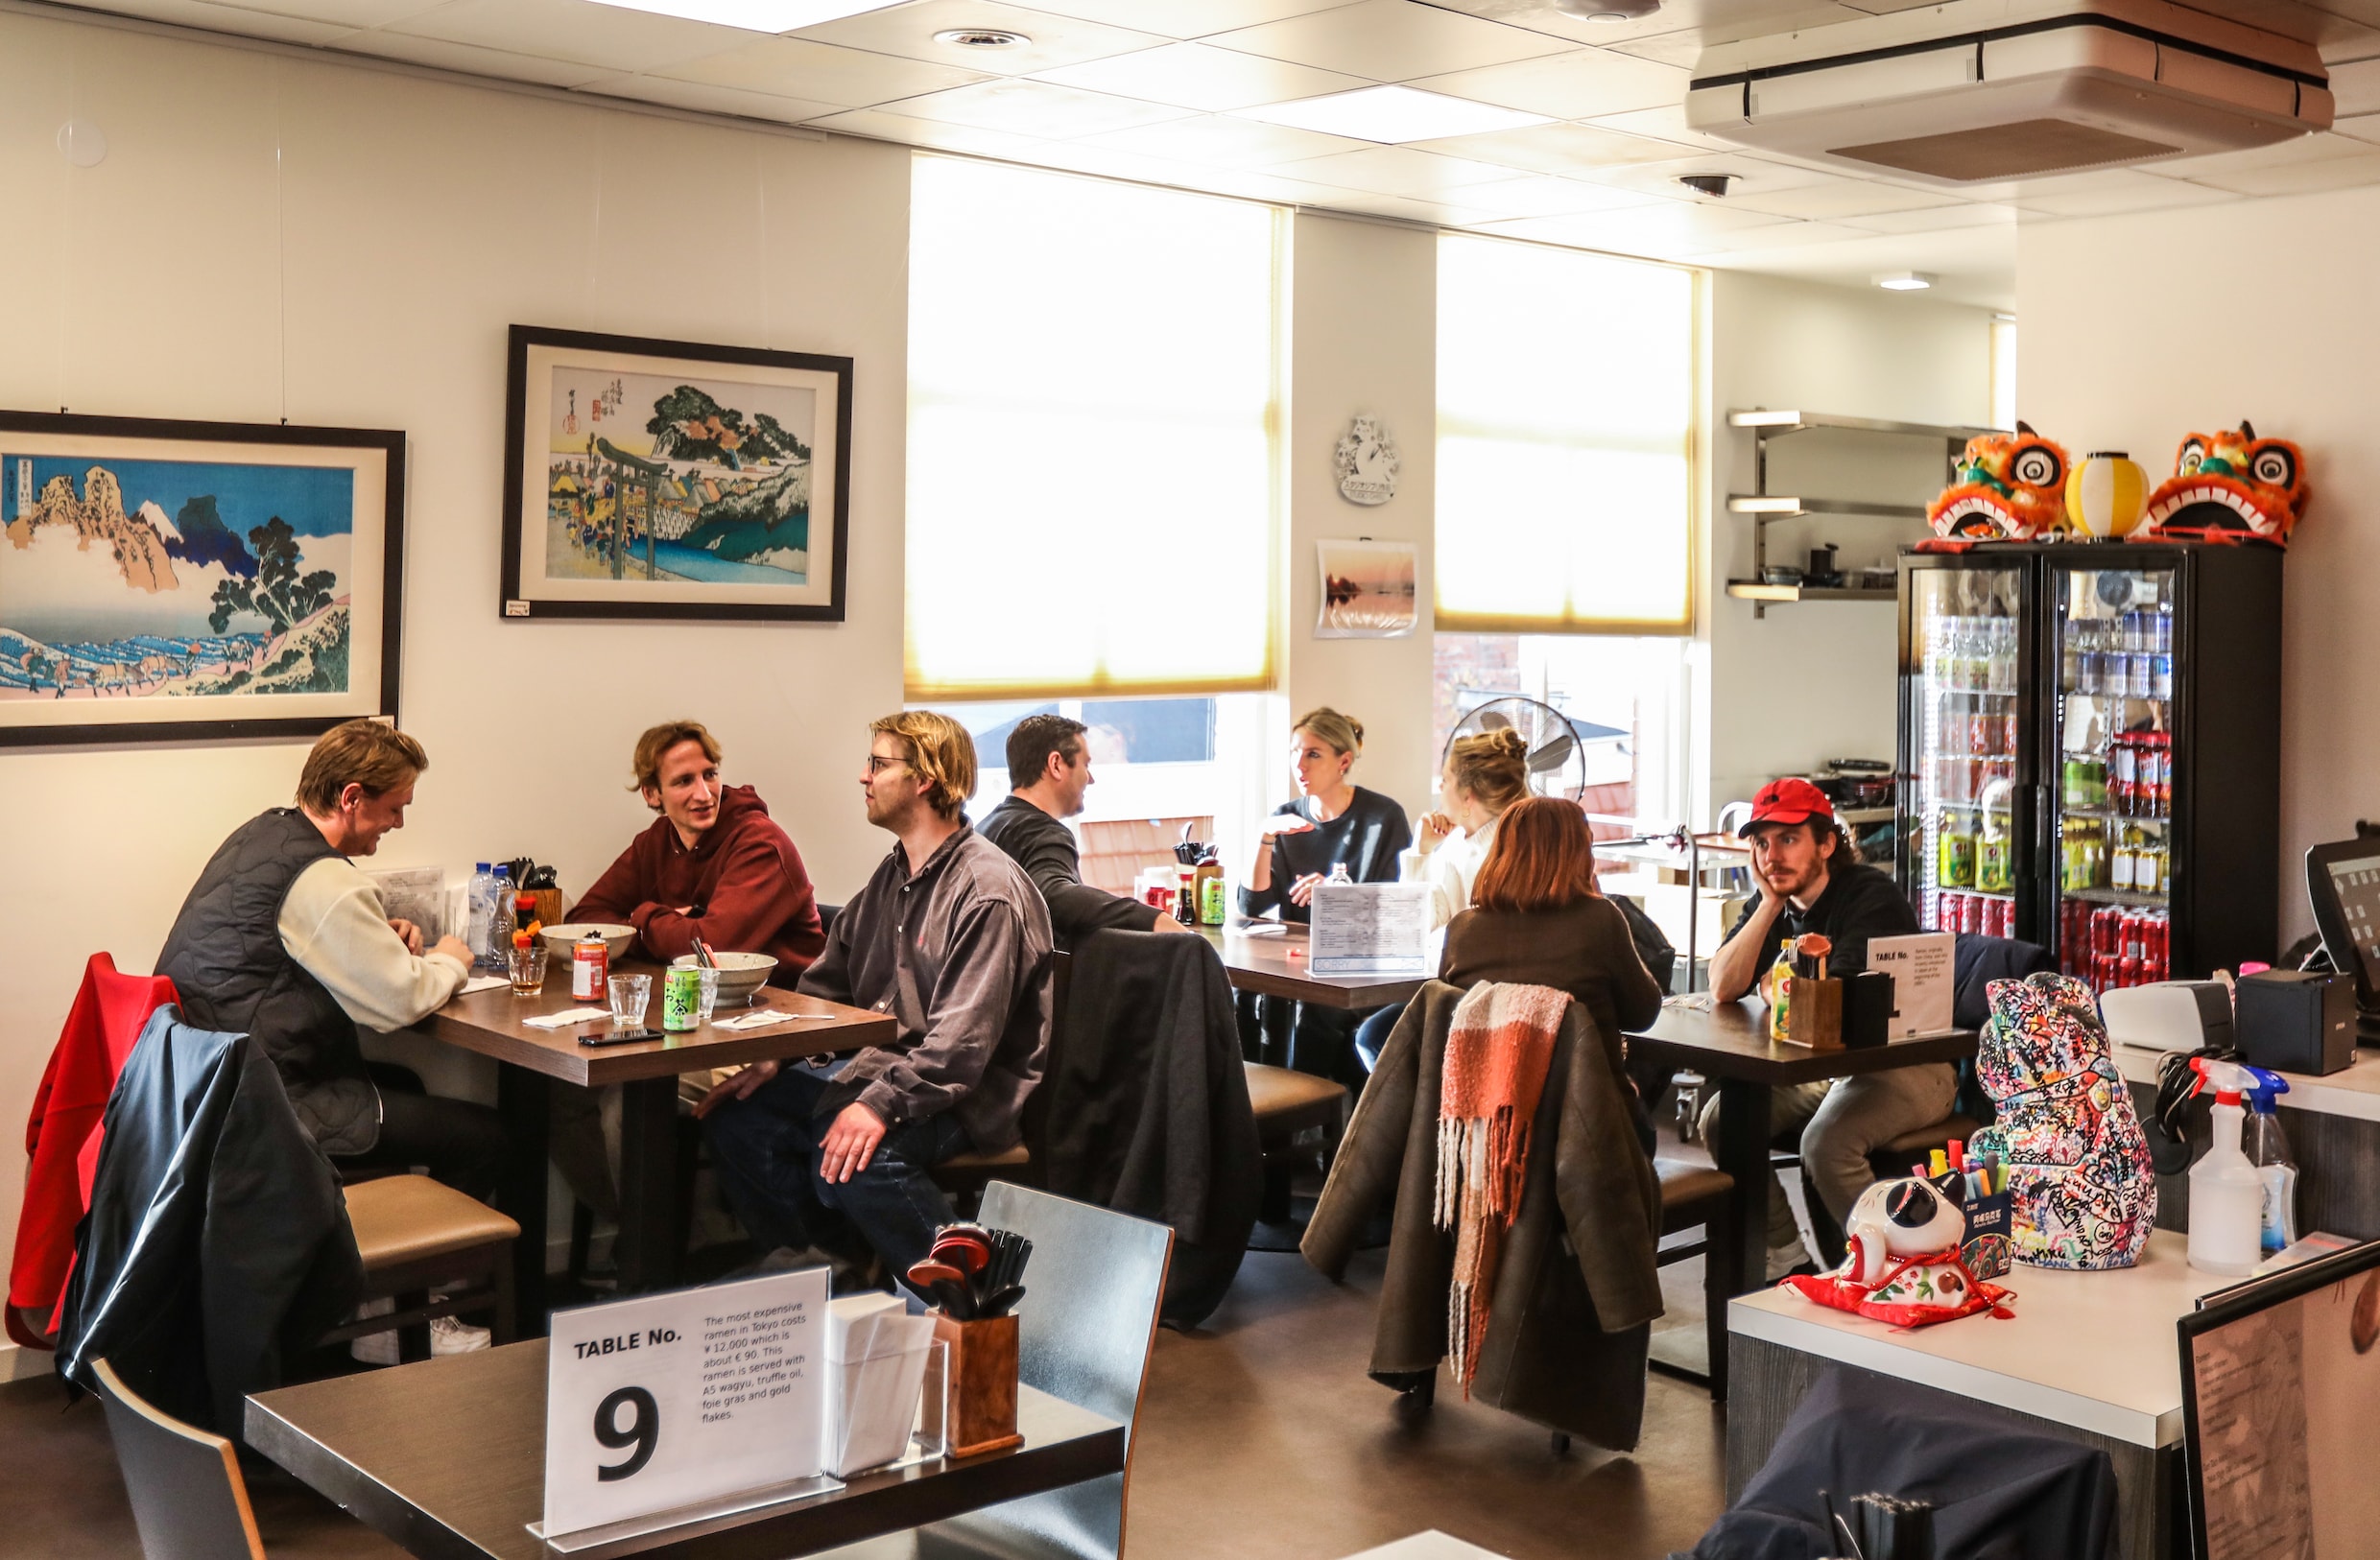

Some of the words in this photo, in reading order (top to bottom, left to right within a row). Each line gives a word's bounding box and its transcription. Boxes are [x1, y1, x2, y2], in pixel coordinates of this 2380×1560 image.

[1875, 952, 1896, 961] TABLE
[1897, 951, 1909, 959] No.
[704, 1317, 724, 1327] The
[726, 1311, 750, 1323] most
[753, 1302, 803, 1318] expensive
[704, 1328, 736, 1341] ramen
[740, 1326, 749, 1335] in
[751, 1320, 778, 1333] Tokyo
[781, 1314, 806, 1327] costs
[574, 1332, 640, 1360] TABLE
[648, 1328, 682, 1347] No.
[714, 1338, 749, 1353] 12,000
[751, 1332, 779, 1345] which
[781, 1331, 790, 1340] is
[703, 1356, 732, 1368] about
[735, 1353, 742, 1362] €
[745, 1350, 759, 1361] 90.
[763, 1345, 783, 1357] This
[703, 1368, 735, 1383] ramen
[738, 1366, 747, 1376] is
[749, 1359, 782, 1374] served
[785, 1355, 805, 1366] with
[702, 1384, 716, 1396] A5
[720, 1380, 754, 1393] wagyu,
[757, 1372, 787, 1385] truffle
[789, 1368, 804, 1380] oil,
[702, 1399, 722, 1410] foie
[724, 1394, 746, 1408] gras
[749, 1388, 767, 1401] and
[770, 1383, 791, 1399] gold
[702, 1410, 734, 1424] flakes.
[593, 1385, 659, 1482] 9
